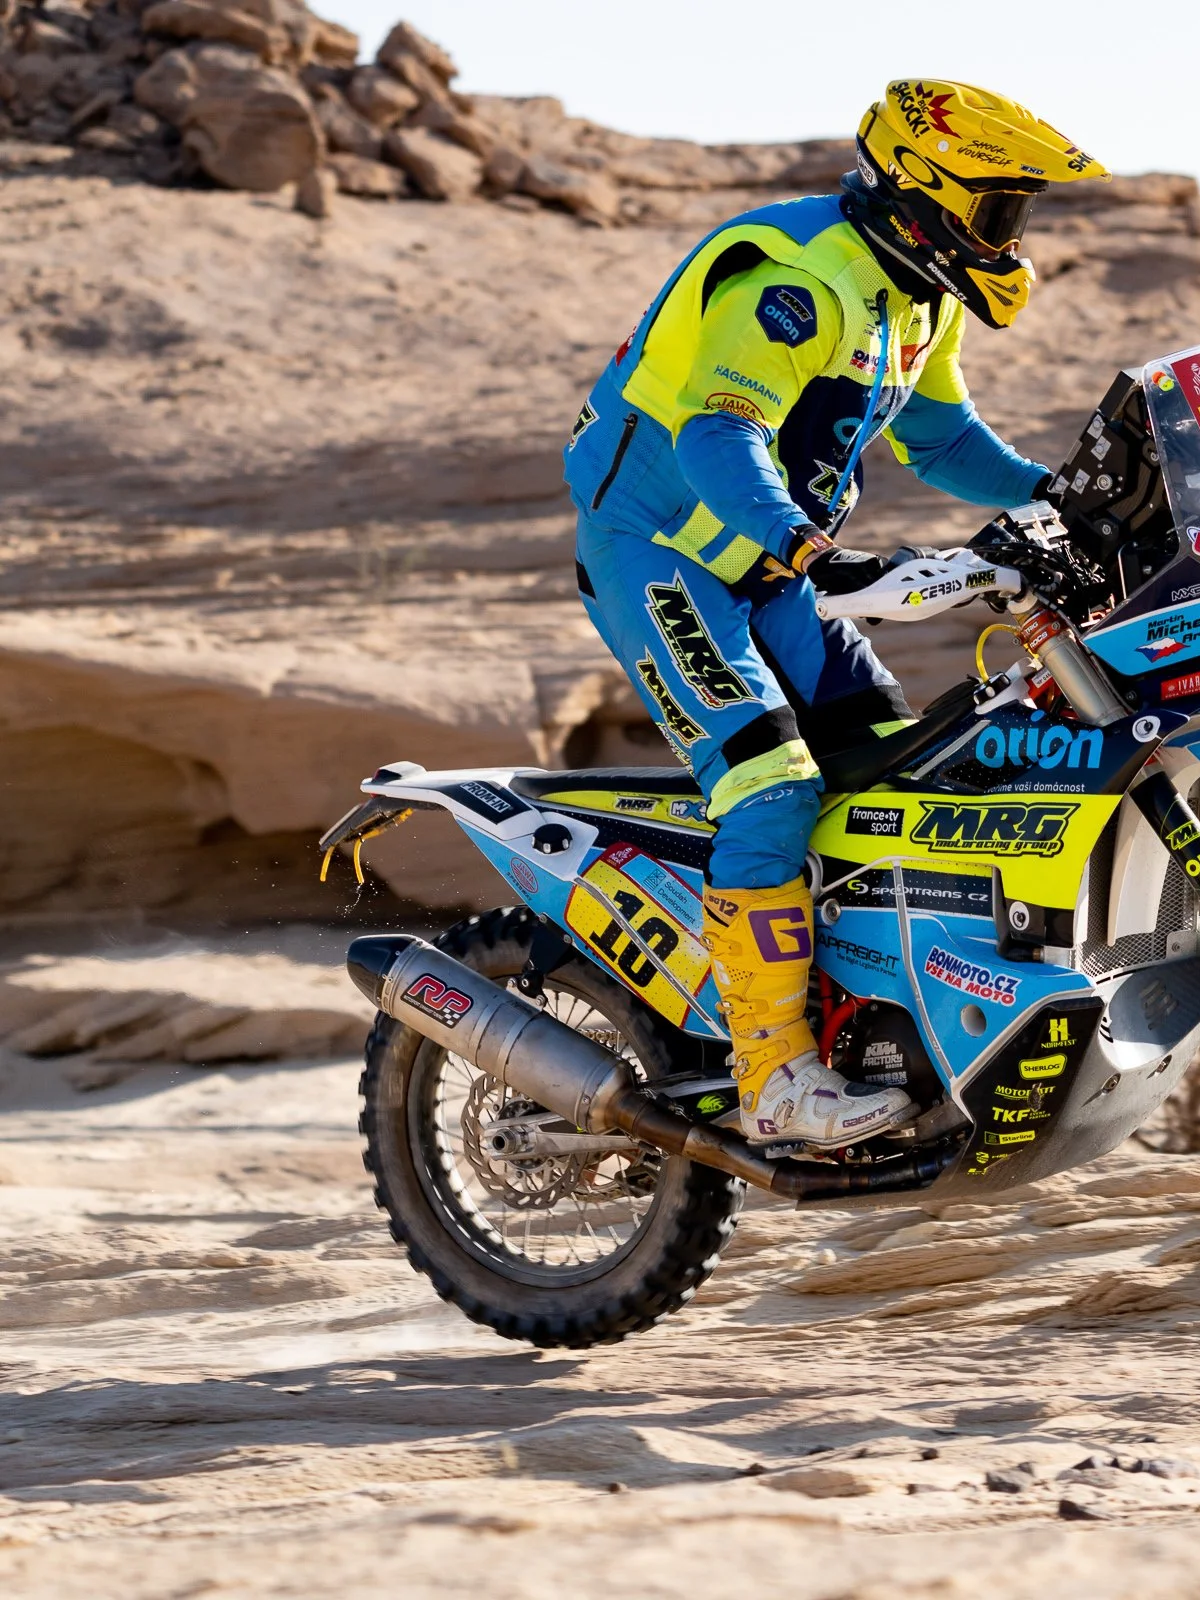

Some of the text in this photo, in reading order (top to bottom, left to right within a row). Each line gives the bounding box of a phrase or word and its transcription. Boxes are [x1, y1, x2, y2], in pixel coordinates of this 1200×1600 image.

[892, 82, 931, 138] SHOCK!
[957, 146, 1014, 168] YOURSELF
[967, 140, 1008, 156] SHOCK
[965, 196, 979, 221] OAKLEY
[889, 215, 919, 248] SHOCK!
[926, 262, 968, 302] BONMOTO.CZ
[764, 305, 801, 341] orion
[714, 364, 782, 407] HAGEMANN
[717, 397, 757, 418] JAWA
[965, 569, 997, 586] MRG
[1148, 614, 1184, 629] Martin
[650, 579, 754, 702] MRG
[975, 709, 1104, 770] orion
[462, 782, 509, 812] PROM-IN
[1033, 782, 1085, 793] domácnost
[615, 799, 654, 809] MRG
[870, 821, 898, 835] sport
[913, 805, 1077, 841] MRG
[934, 839, 1060, 852] motoracing group
[664, 881, 688, 904] Soudah
[967, 893, 988, 901] CZ
[657, 888, 696, 925] Development
[589, 890, 679, 987] 10
[748, 907, 812, 963] G
[928, 947, 1019, 993] BONMOTO.CZ
[925, 961, 1015, 1006] VSE NA MOTO
[862, 1053, 903, 1067] FACTORY
[865, 1041, 897, 1058] KTM
[1024, 1064, 1060, 1072] SHERLOG
[992, 1107, 1031, 1123] TKF
[757, 1119, 779, 1135] G
[1002, 1133, 1033, 1142] Starline
